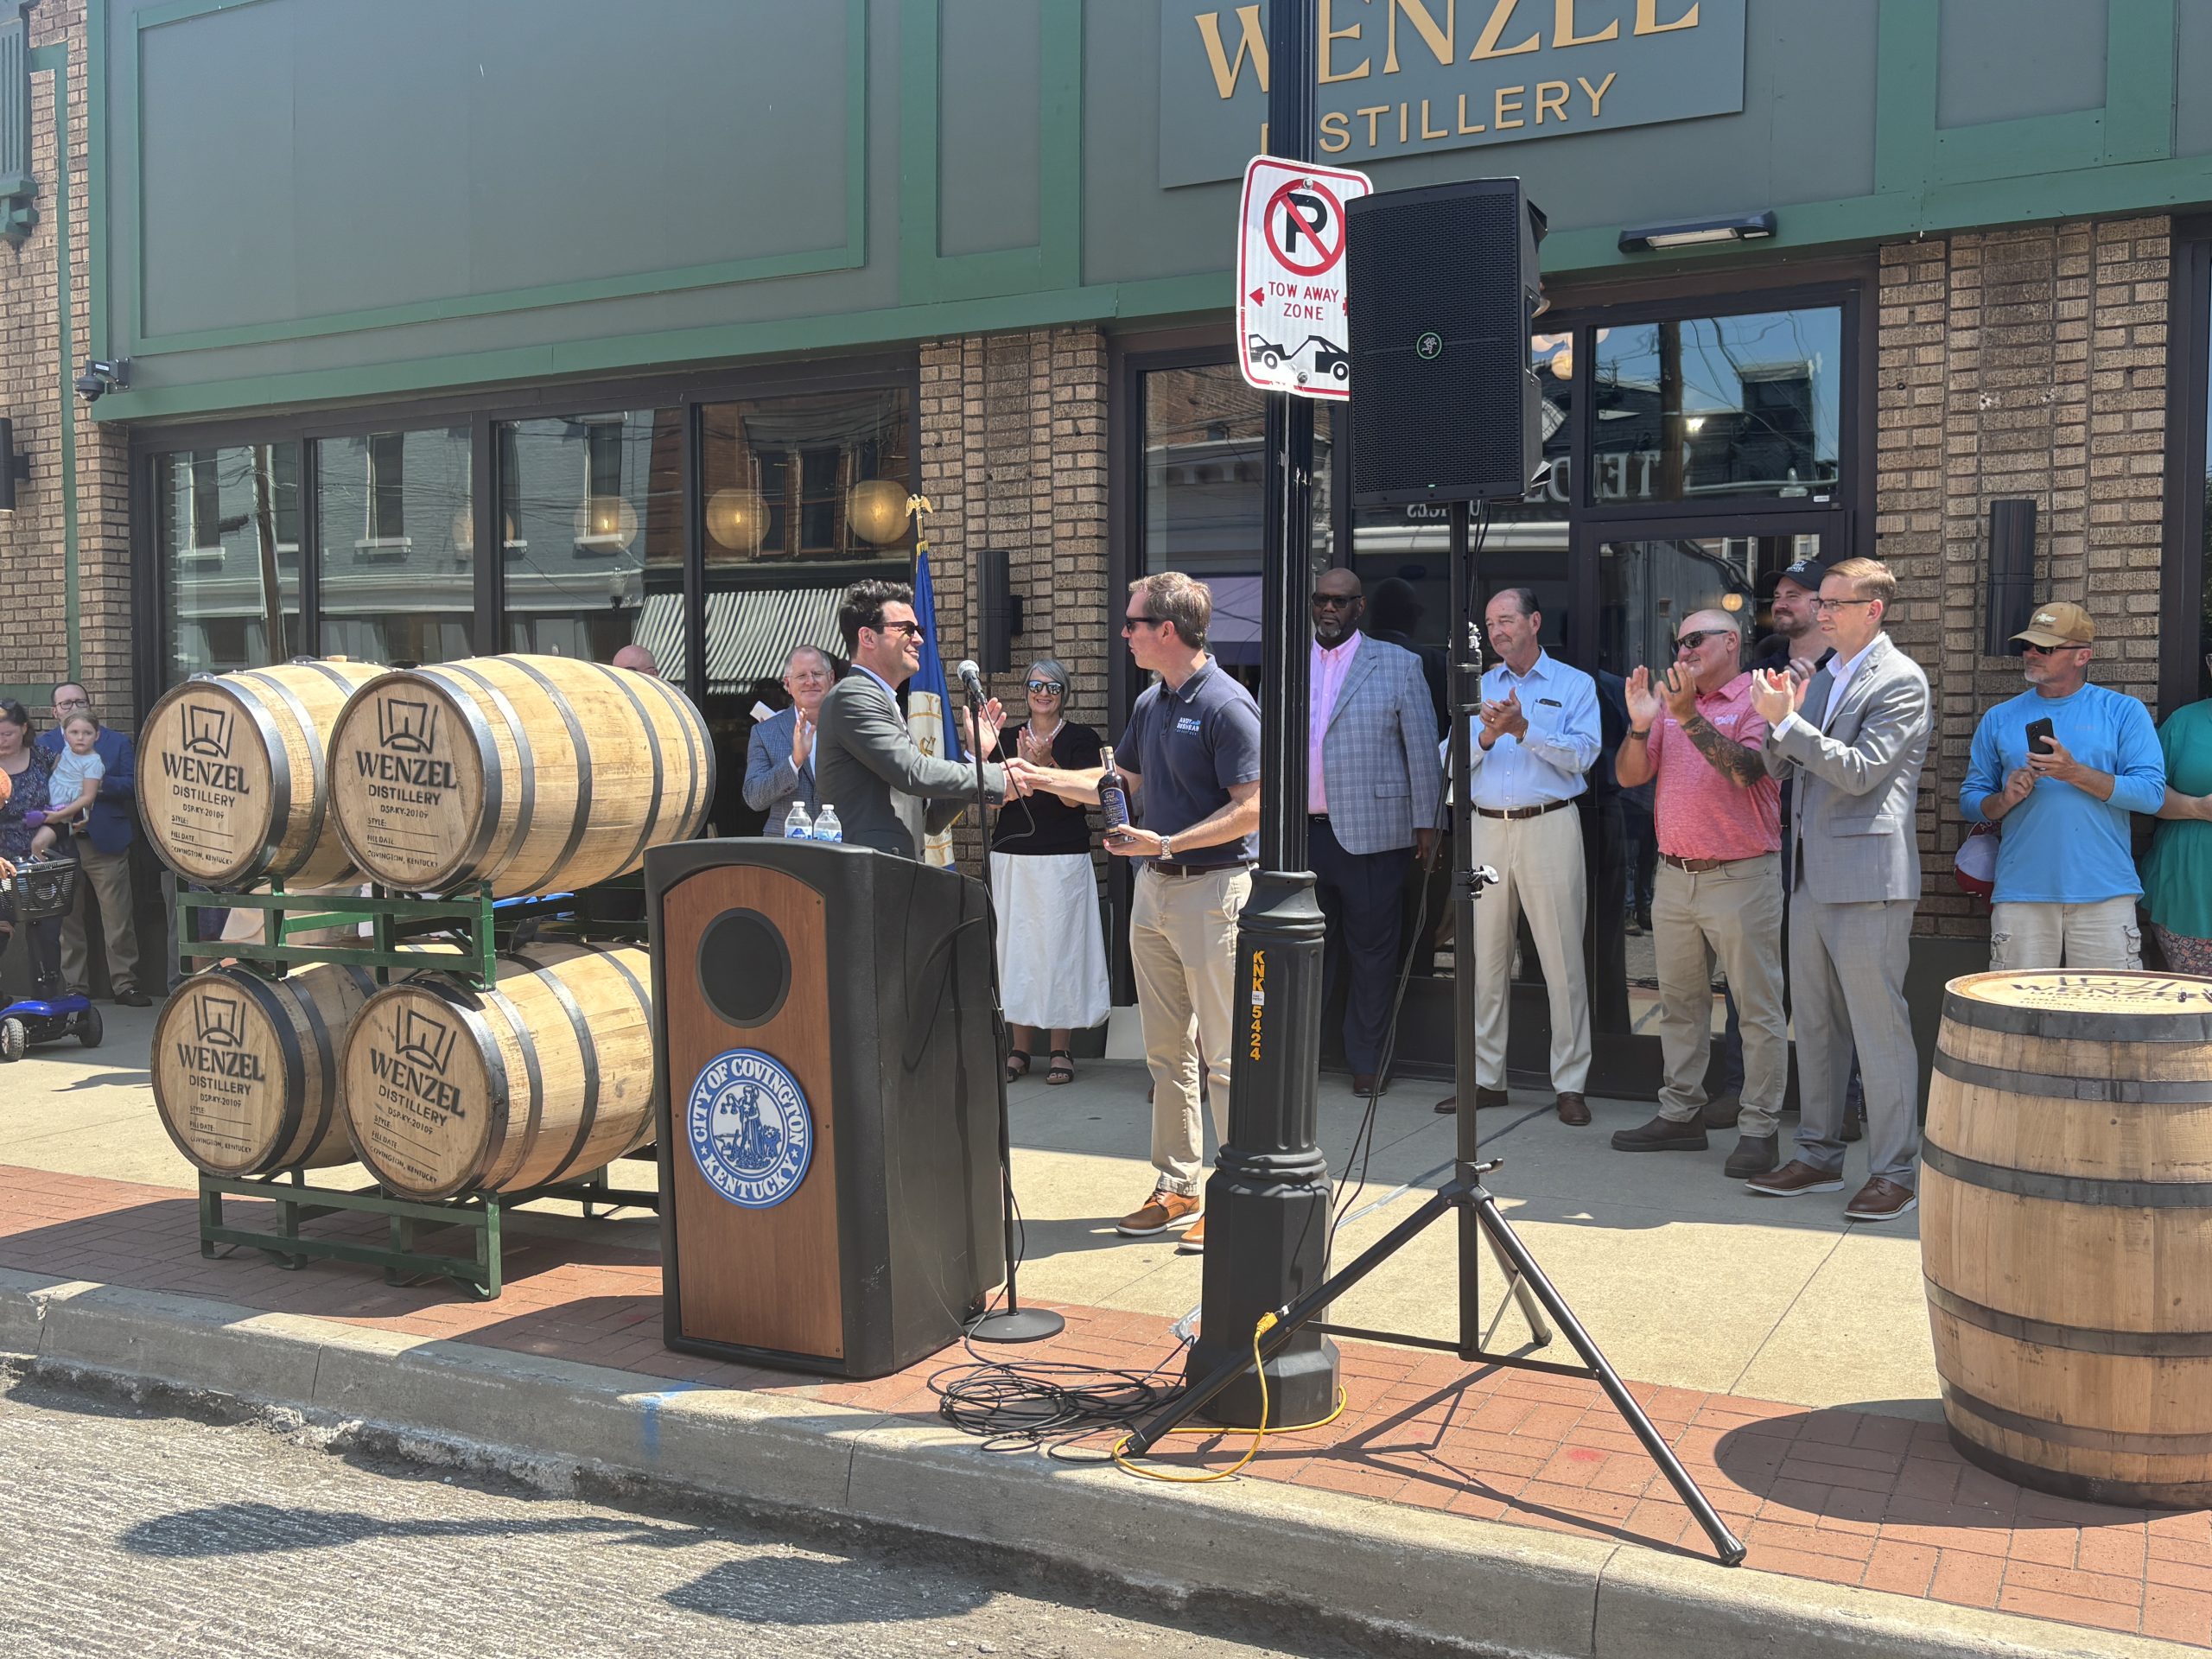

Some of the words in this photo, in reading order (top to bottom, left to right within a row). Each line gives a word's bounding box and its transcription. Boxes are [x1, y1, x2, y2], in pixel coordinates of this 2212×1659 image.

[1260, 72, 1618, 155] STILLERY
[1268, 281, 1297, 297] TOW
[1304, 286, 1339, 302] AWAY
[1283, 302, 1324, 321] ZONE
[162, 752, 250, 795] WENZEL
[355, 750, 457, 790] WENZEL
[173, 784, 236, 808] DISTILLERY
[368, 784, 442, 805] DISTILLERY
[1252, 950, 1265, 991] KNK
[1250, 1006, 1262, 1061] 5424
[177, 1043, 265, 1083] WENZEL
[371, 1047, 466, 1118] WENZEL
[189, 1074, 251, 1096] DISTILLERY
[693, 1082, 713, 1143] CITY
[707, 1062, 728, 1089] OF
[731, 1058, 804, 1147] COVINGTON
[378, 1084, 448, 1128] DISTILLERY
[702, 1153, 798, 1199] KENTUCKY
